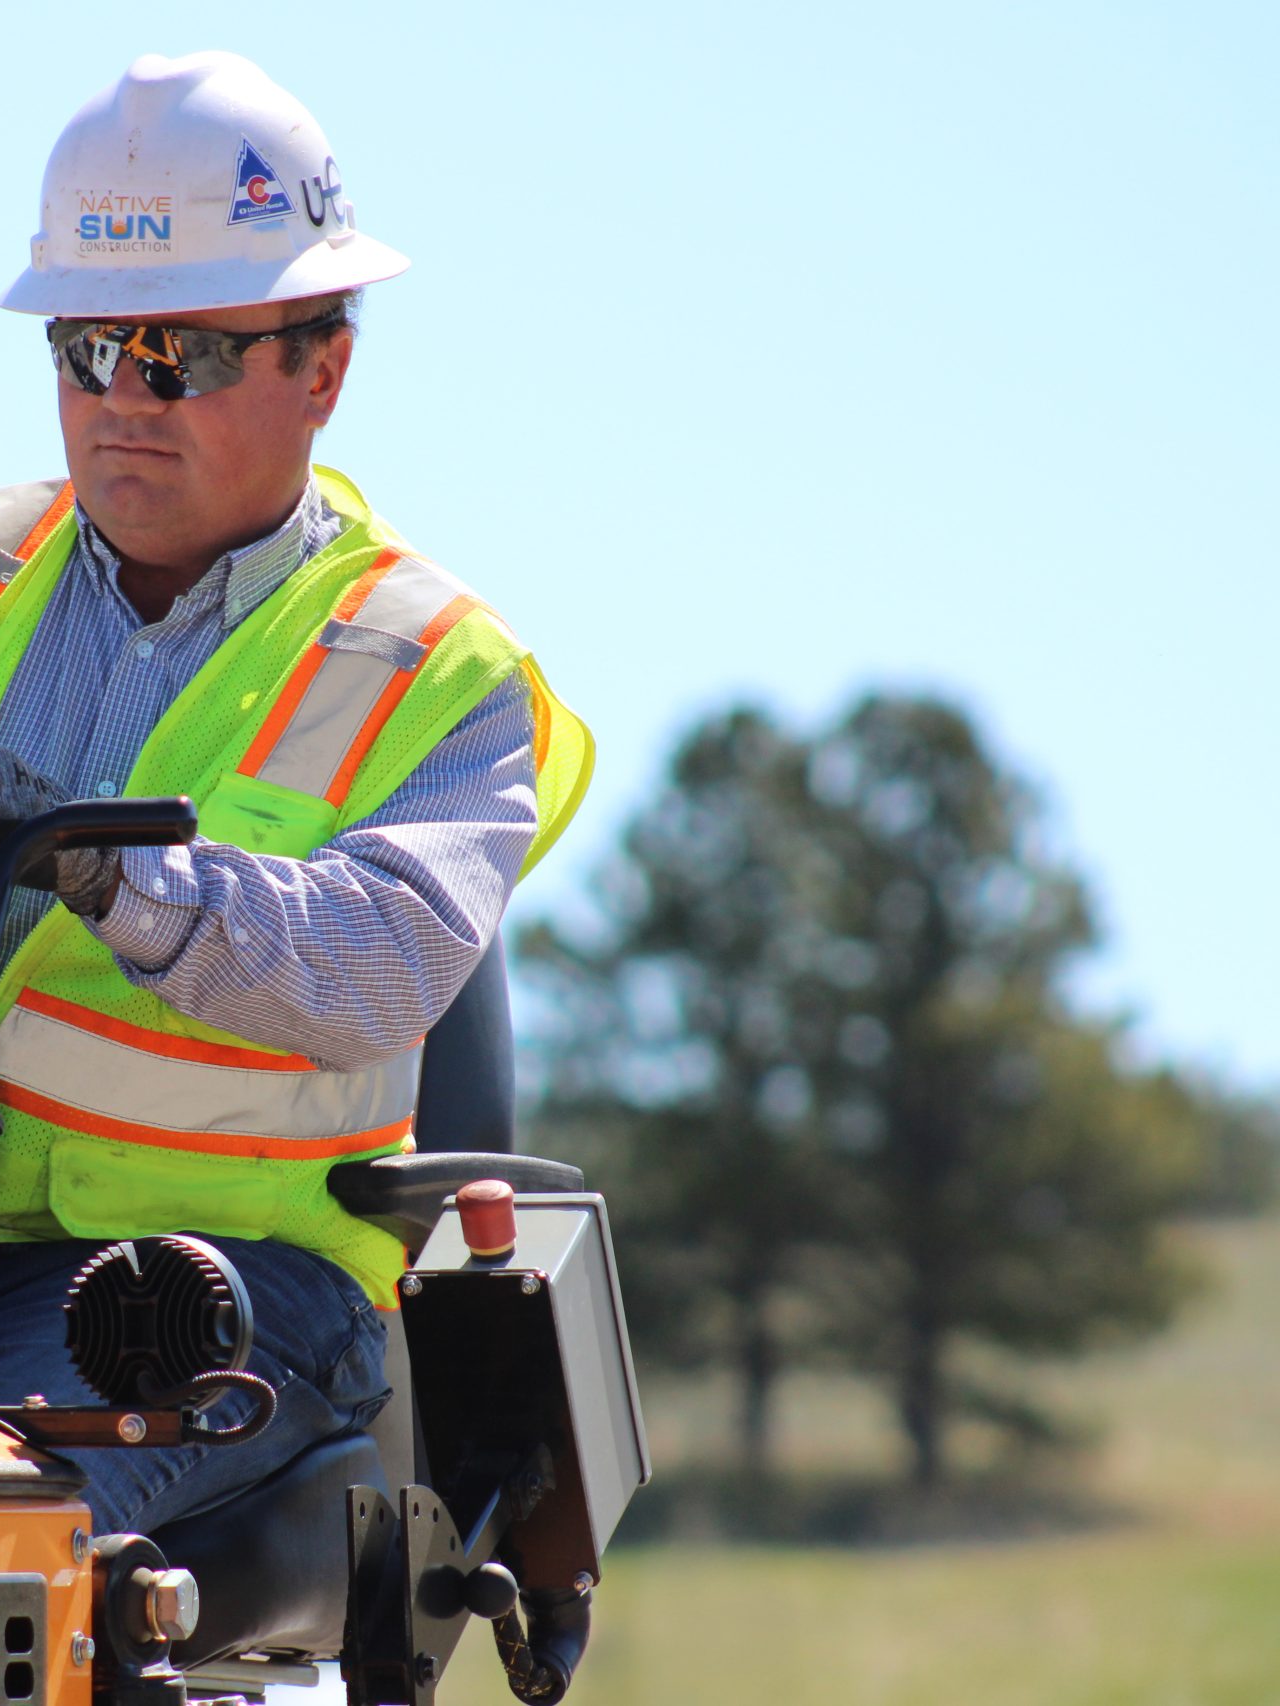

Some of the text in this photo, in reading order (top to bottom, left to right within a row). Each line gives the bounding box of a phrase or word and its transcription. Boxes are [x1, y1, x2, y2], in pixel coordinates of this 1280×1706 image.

[80, 196, 171, 212] NATIVE
[80, 215, 171, 240] SUN
[80, 241, 172, 252] CONSTRUCTION
